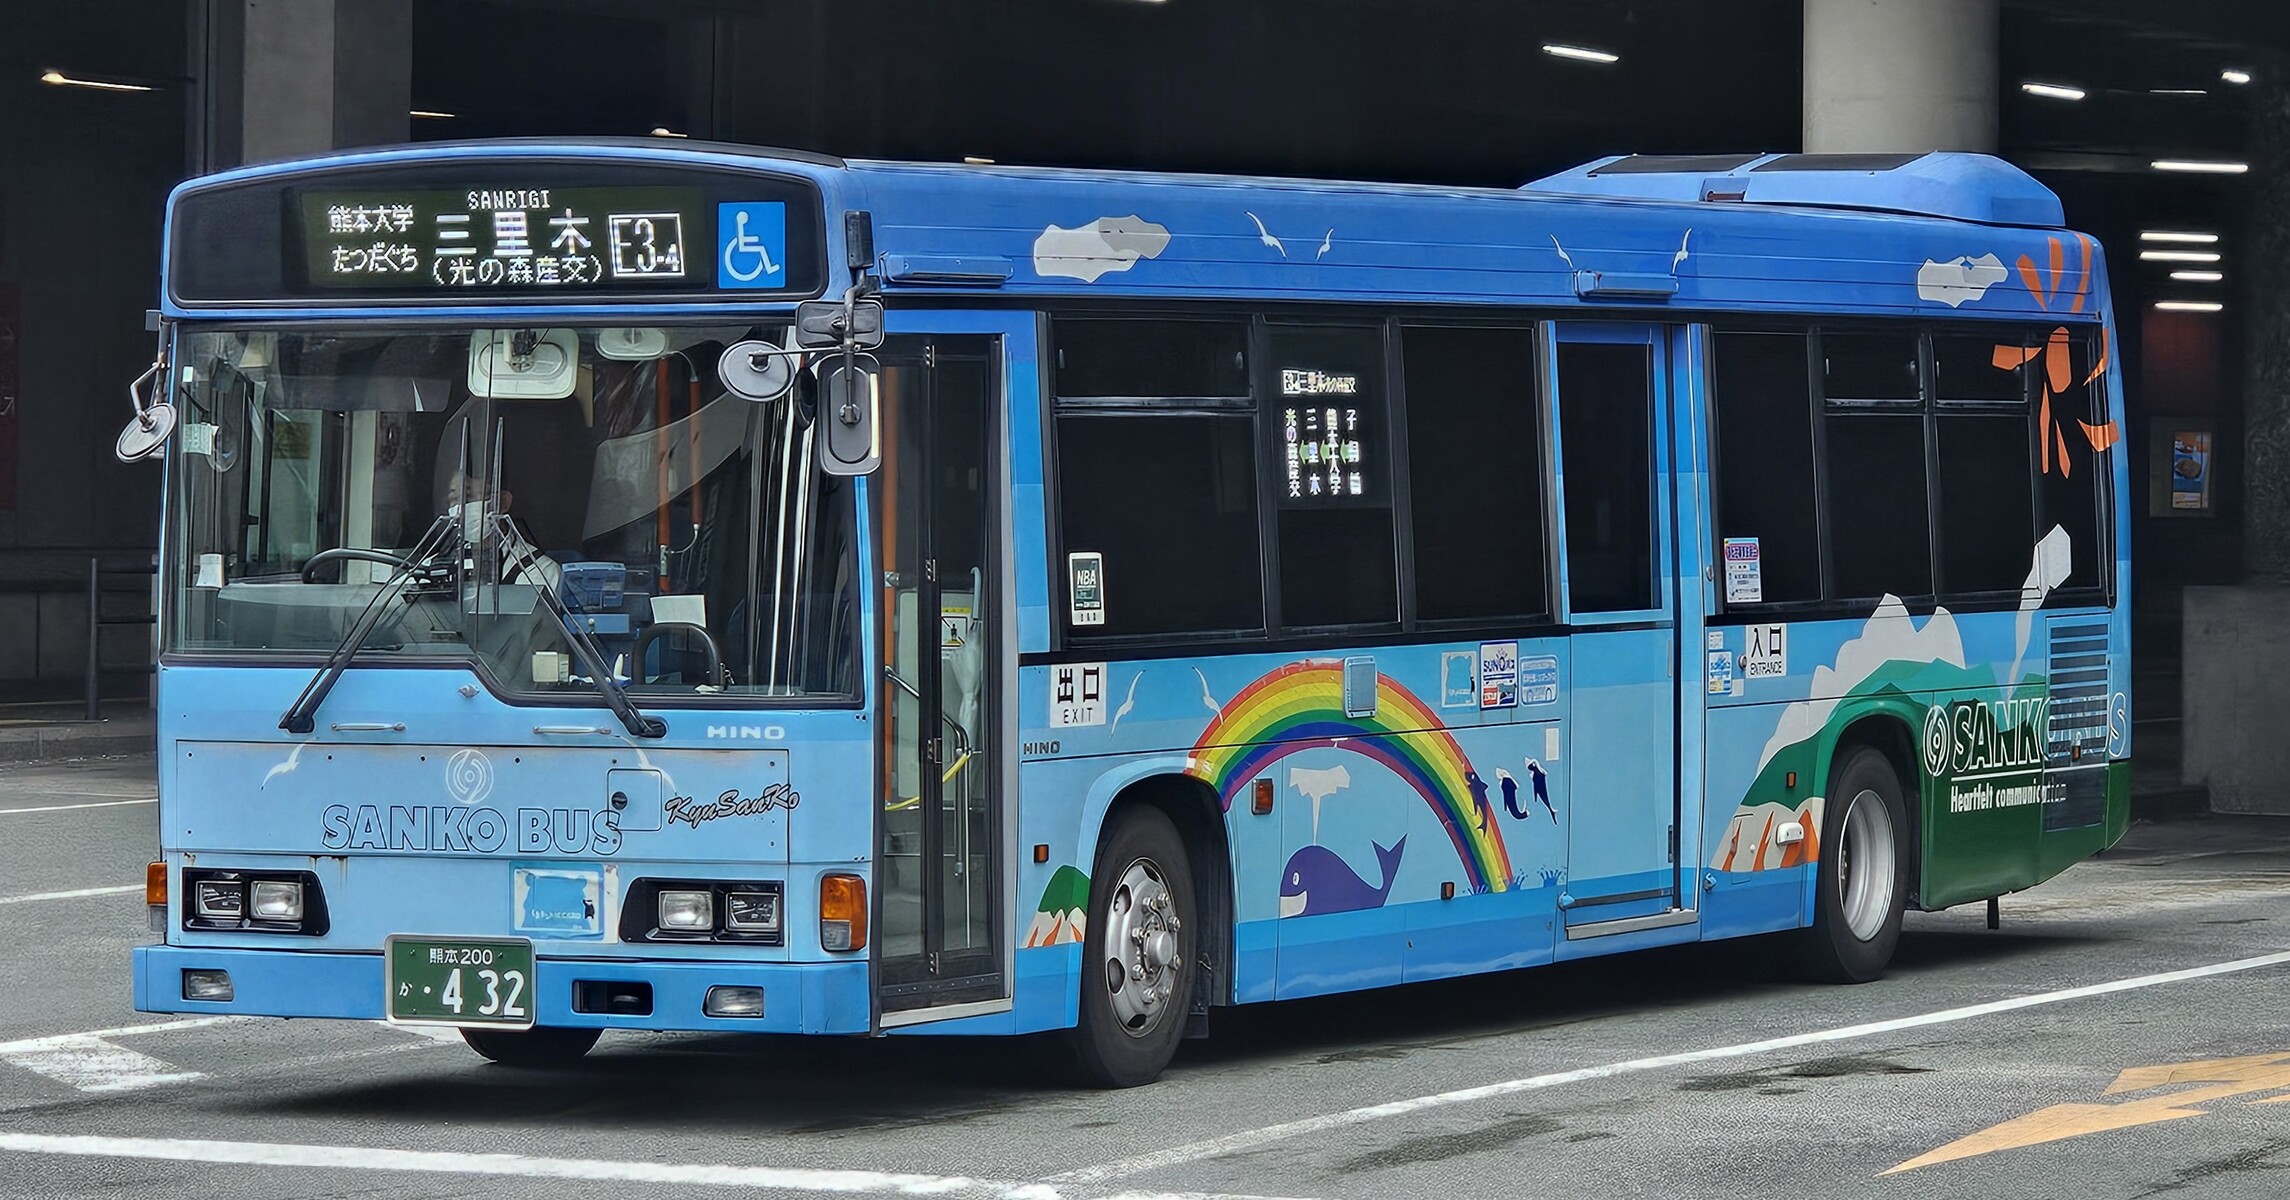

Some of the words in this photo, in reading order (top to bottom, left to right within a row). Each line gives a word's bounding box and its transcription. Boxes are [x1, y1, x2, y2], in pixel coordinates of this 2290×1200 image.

[467, 190, 551, 210] SANRIGI
[328, 204, 415, 233] 熊本大学
[434, 208, 592, 256] 三里木
[332, 241, 418, 272] たつだぐち
[1751, 626, 1782, 658] 入口
[1057, 667, 1100, 704] 出口
[1063, 707, 1093, 724] EXIT
[706, 725, 786, 740] HINO
[1023, 740, 1060, 755] HINO
[665, 783, 801, 829] KyuSanKo
[1950, 781, 1994, 813] Heartfelt
[321, 804, 508, 853] SANKO
[517, 807, 623, 856] BUS
[398, 982, 413, 997] か
